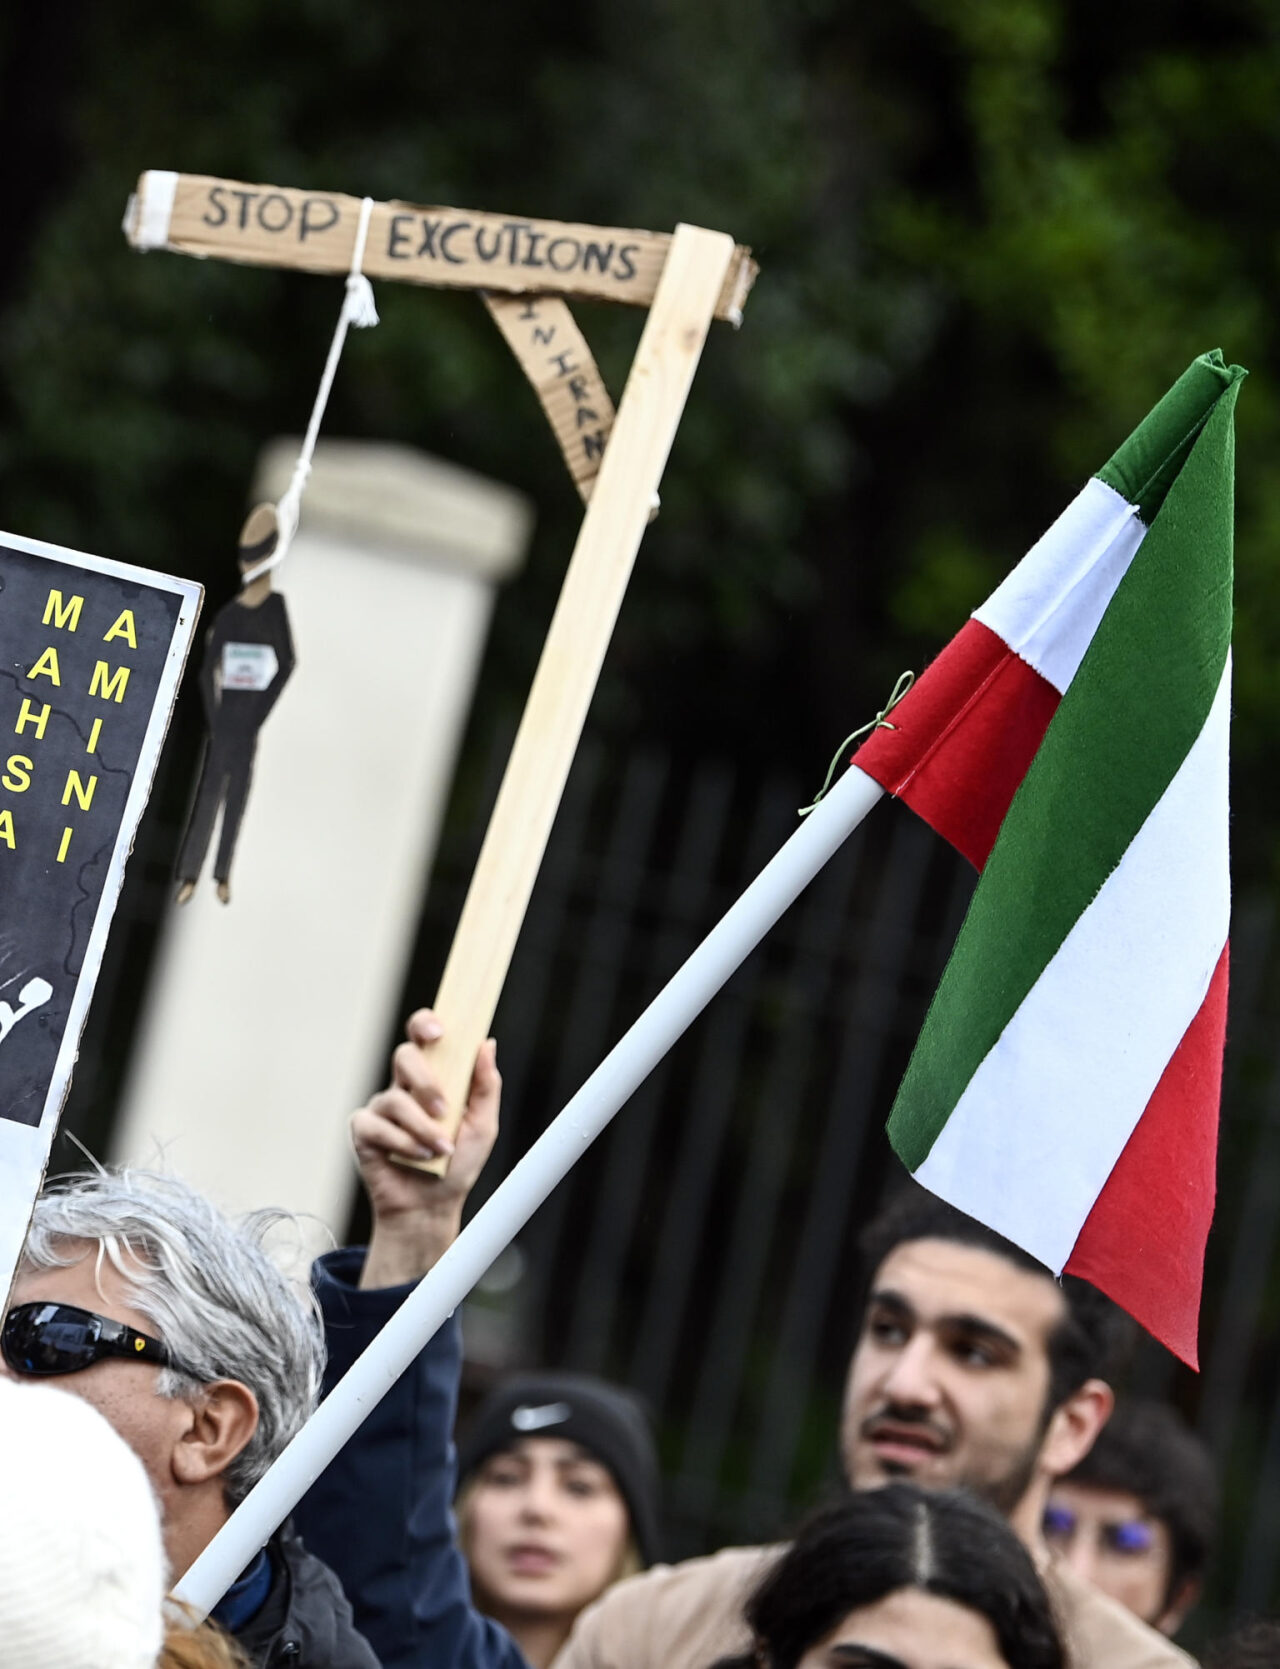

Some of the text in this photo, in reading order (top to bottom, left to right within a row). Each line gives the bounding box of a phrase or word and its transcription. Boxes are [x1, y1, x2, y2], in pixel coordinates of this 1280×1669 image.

[202, 186, 642, 281] STOP EXCUTIONS
[546, 350, 605, 460] IRAN
[55, 608, 138, 864] AMINI
